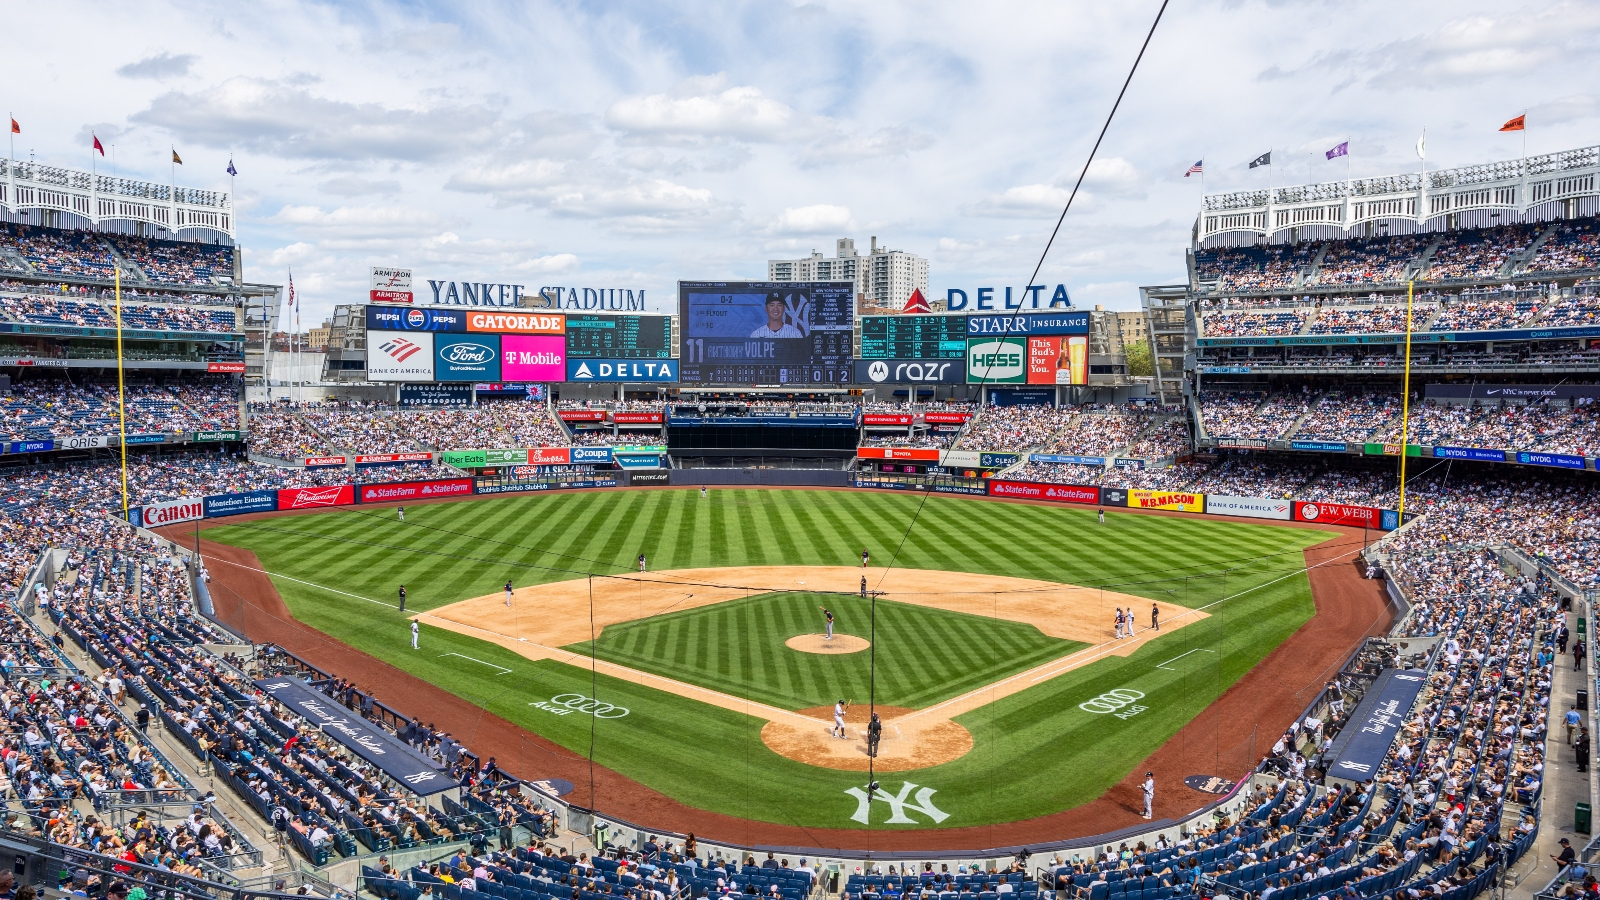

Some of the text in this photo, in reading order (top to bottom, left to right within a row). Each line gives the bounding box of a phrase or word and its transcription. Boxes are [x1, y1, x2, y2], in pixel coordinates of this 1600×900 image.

[373, 270, 411, 278] ARMITRON
[376, 291, 410, 299] ARMITRON
[427, 279, 647, 311] YANKEE STADIUM
[947, 283, 1072, 311] DELTA
[472, 314, 561, 331] GATORADE
[969, 316, 1087, 333] STARR INSURANCE
[449, 345, 486, 362] Ford
[686, 338, 704, 362] 11
[745, 342, 775, 358] VOLPE
[519, 352, 561, 366] Mobile
[972, 353, 1020, 367] HESS
[600, 363, 672, 377] DELTA
[814, 371, 847, 381] 0 1 2
[896, 363, 950, 380] razr
[70, 438, 98, 448] ORIS
[445, 455, 464, 464] Uber
[584, 450, 607, 458] coupa
[209, 495, 271, 507] Montefiore Einstein
[296, 493, 337, 502] Budweiser
[144, 502, 201, 525] Canon
[1320, 506, 1372, 519] F.W. WEBB
[528, 701, 574, 716] Audi
[1114, 705, 1149, 720] Audi
[844, 781, 951, 825] NY
